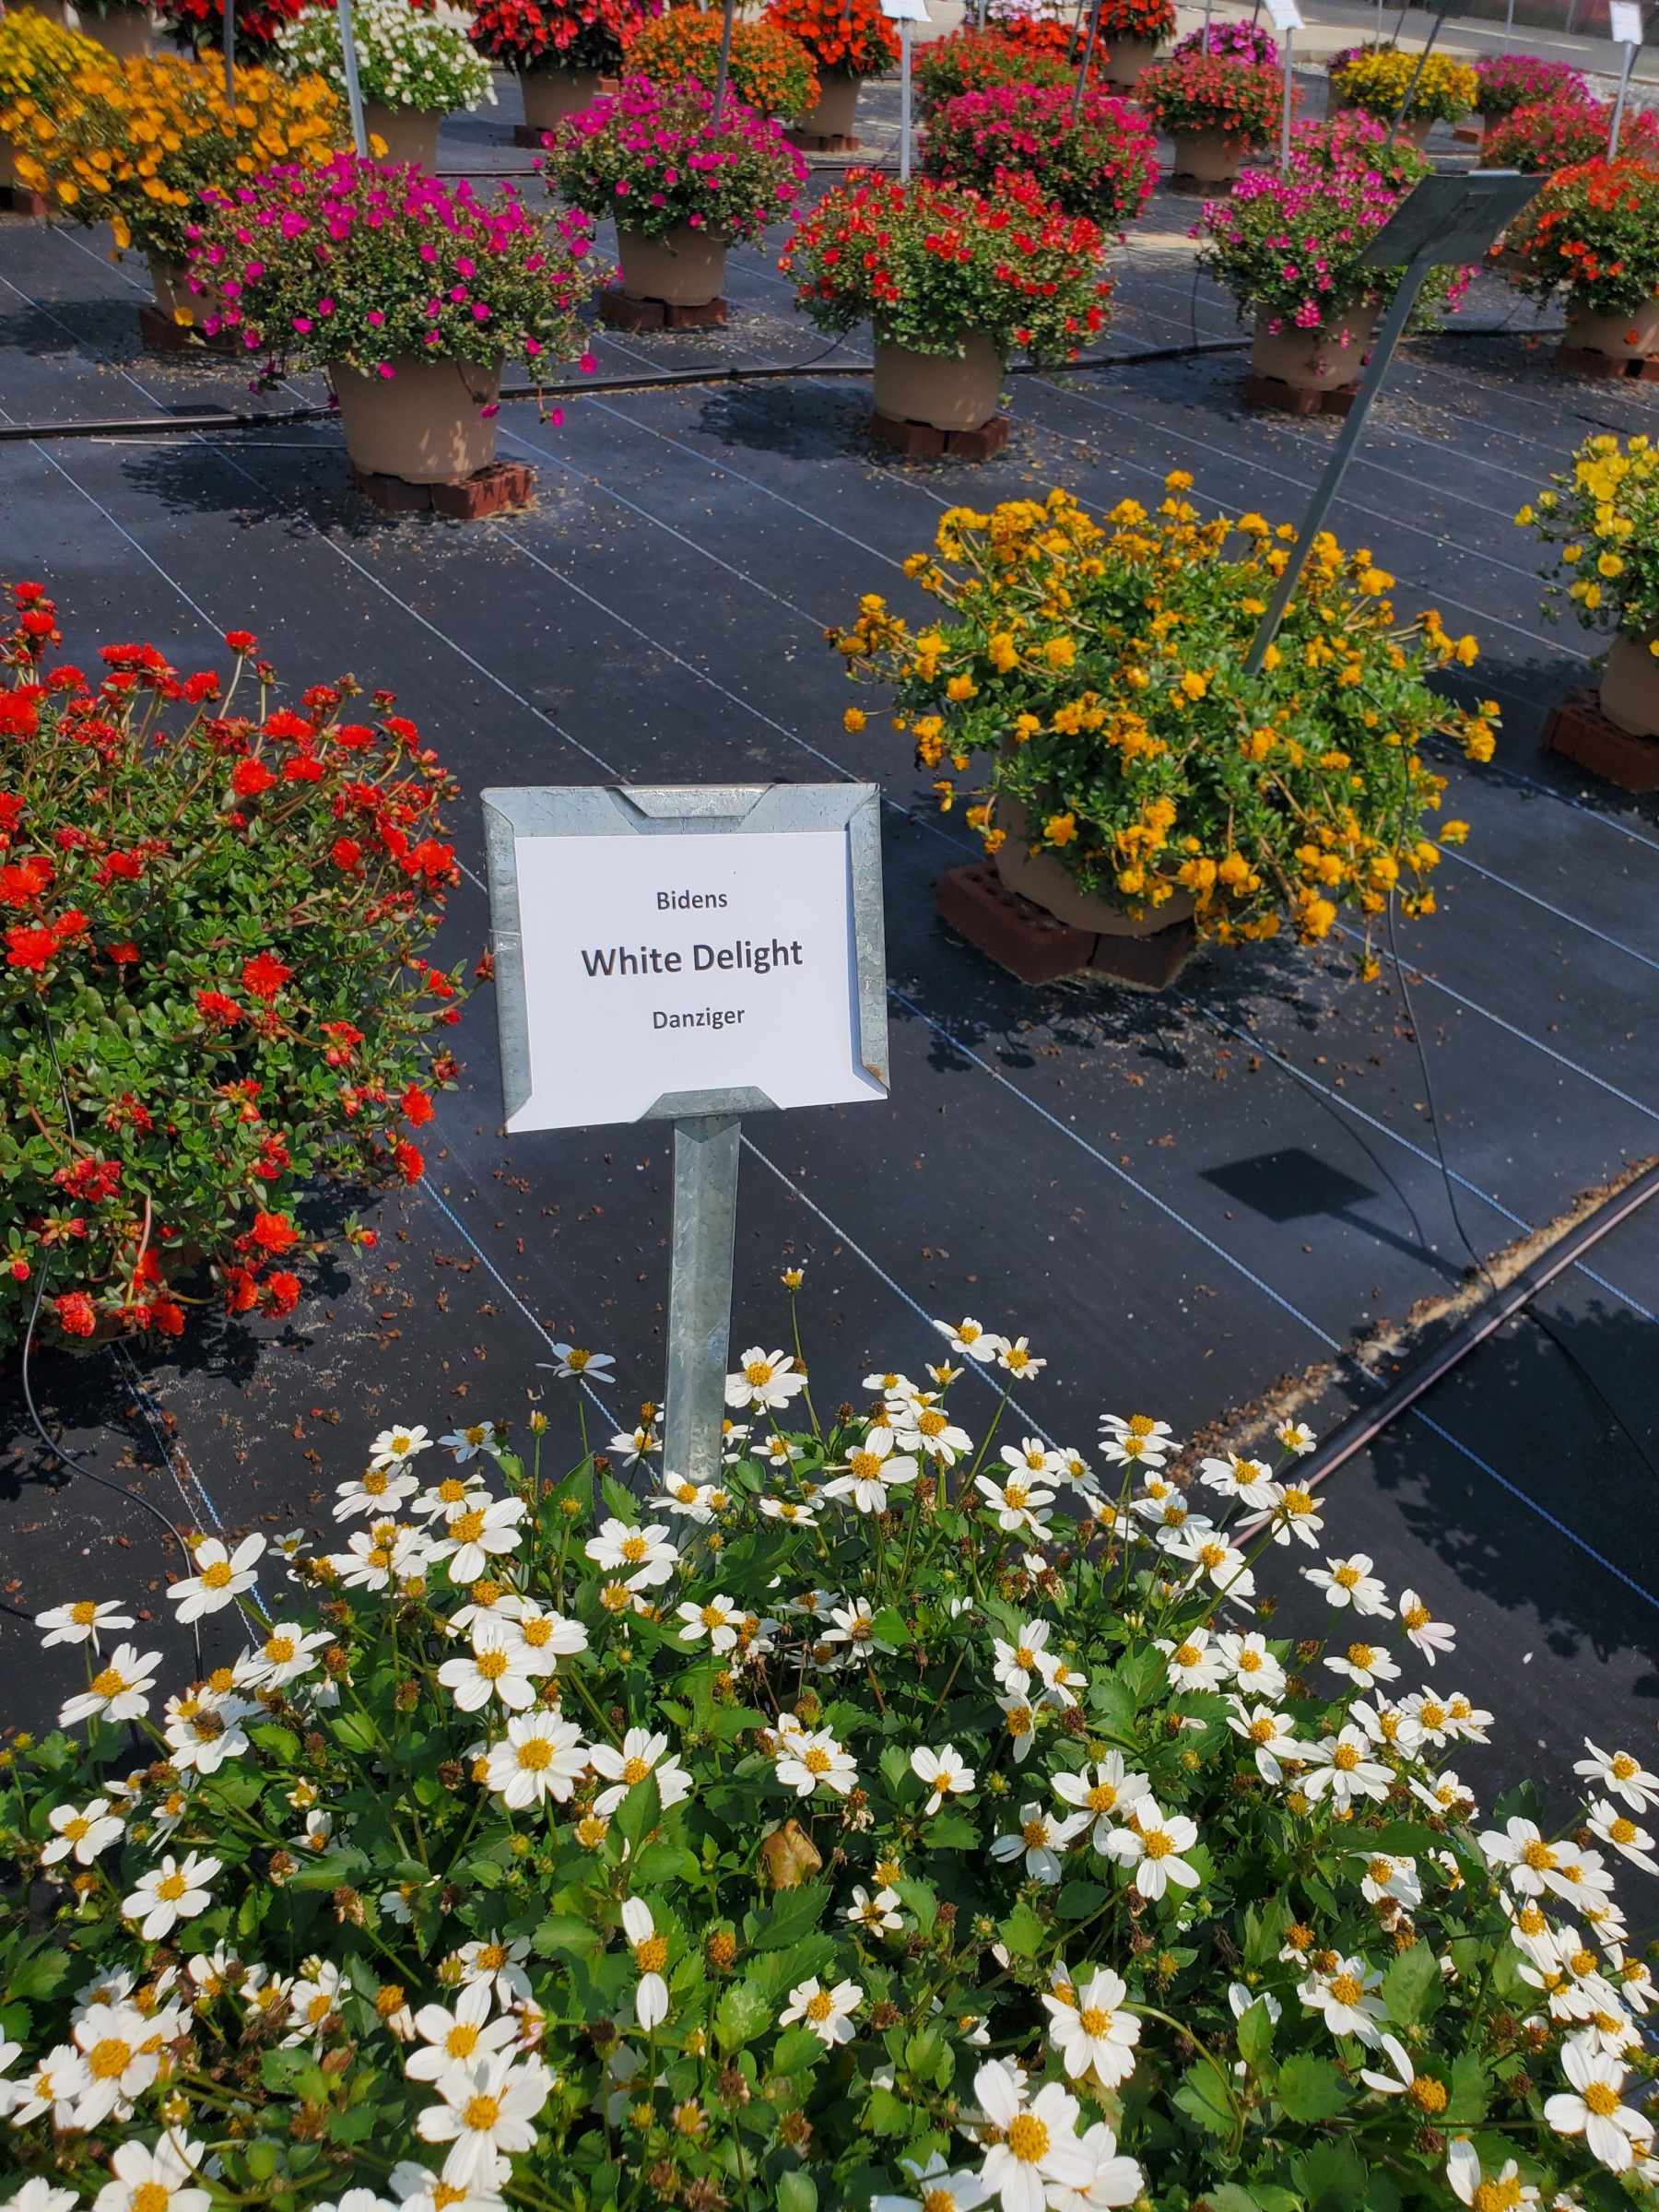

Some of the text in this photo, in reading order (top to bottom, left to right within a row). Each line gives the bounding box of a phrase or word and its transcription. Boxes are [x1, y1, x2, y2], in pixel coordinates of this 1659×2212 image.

[656, 889, 727, 910] Bidens
[581, 938, 803, 977] White Delight
[653, 1006, 746, 1030] Danziger
